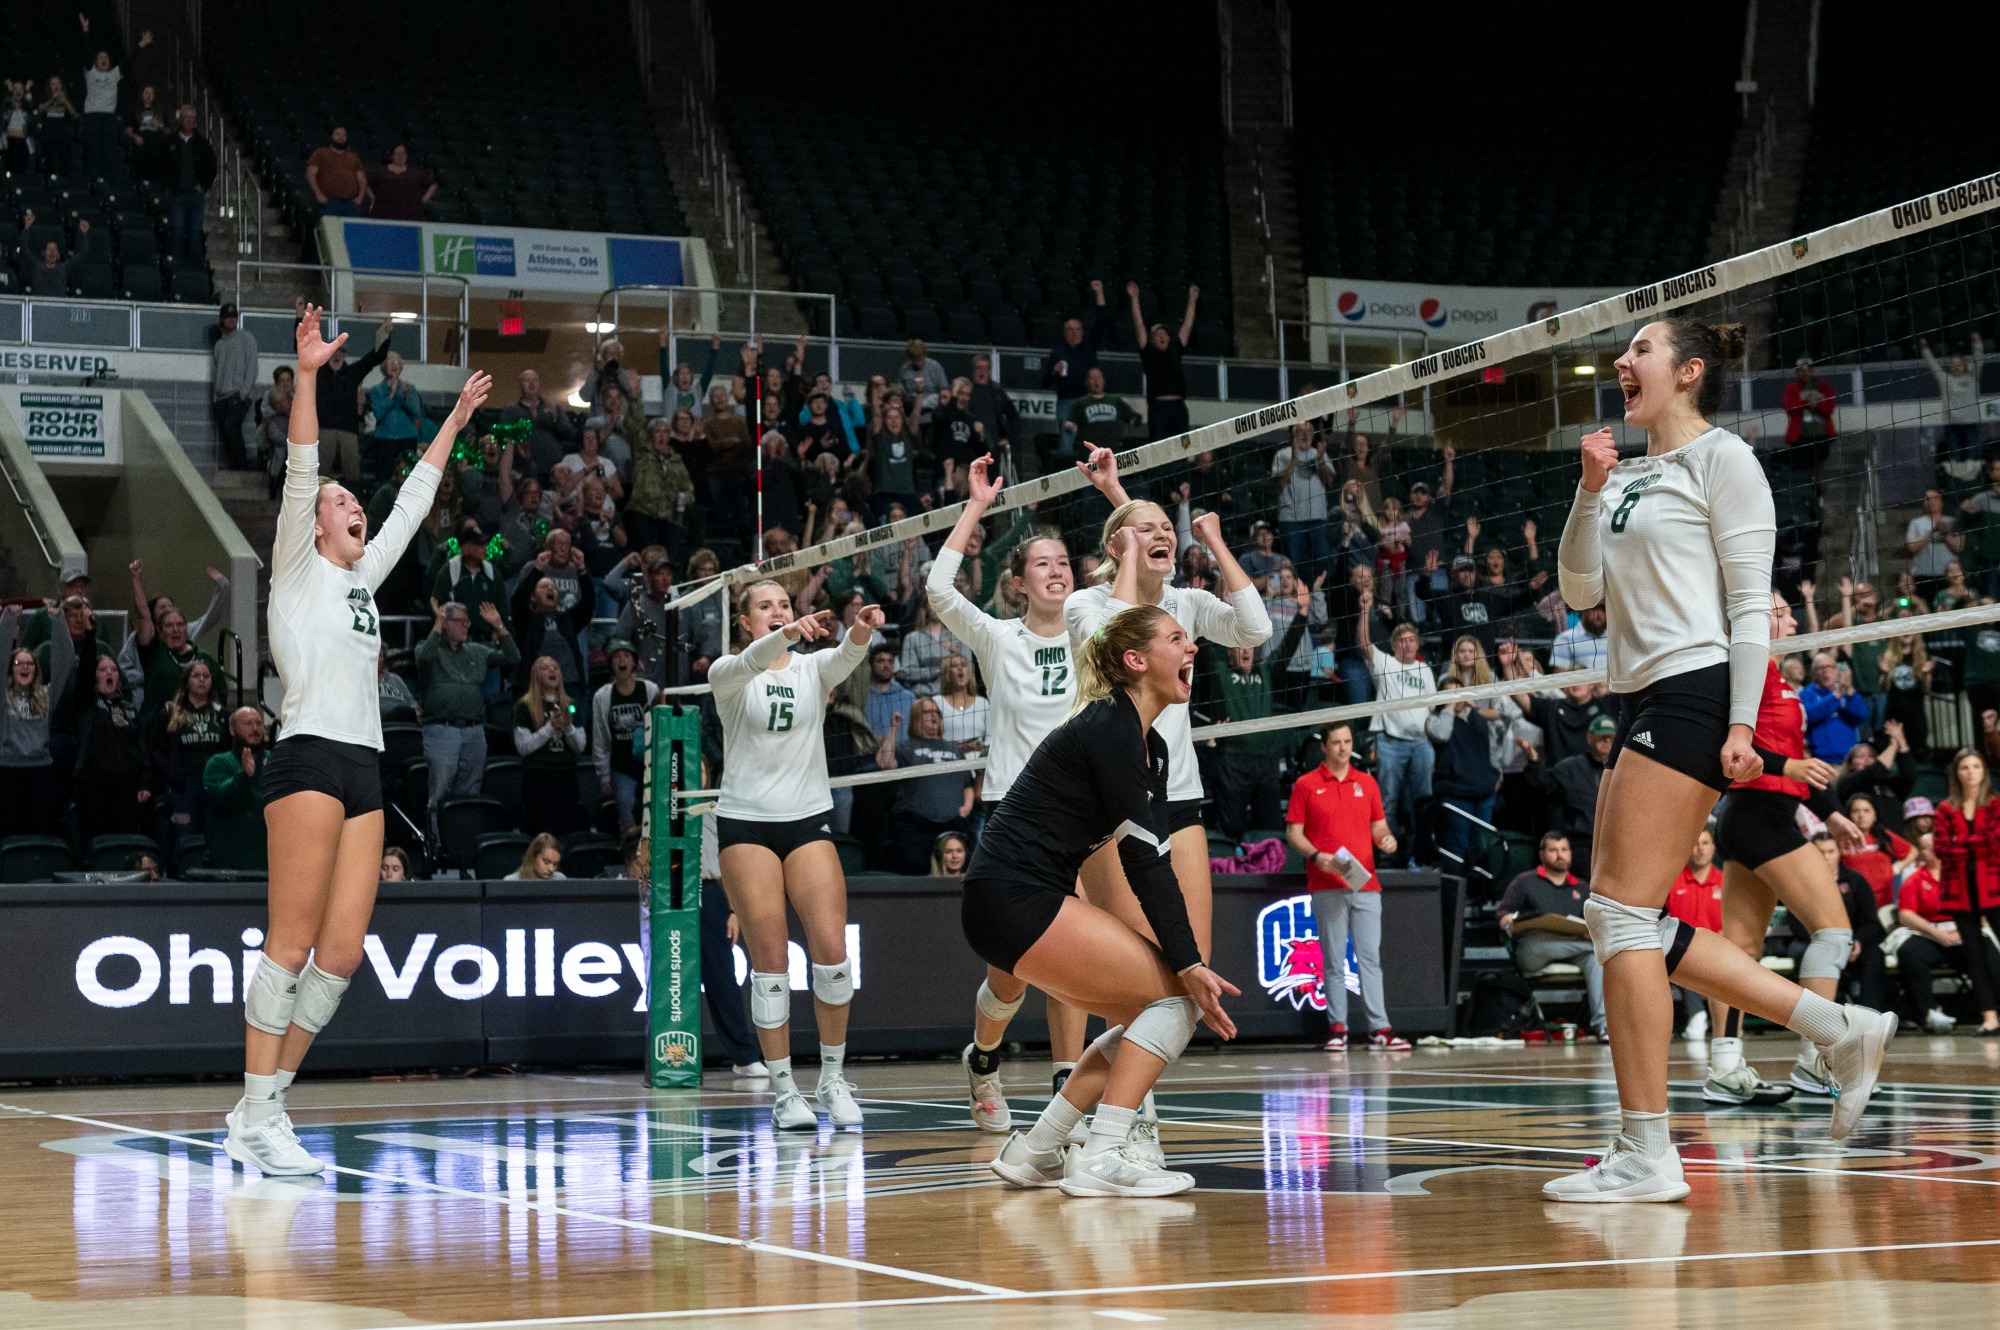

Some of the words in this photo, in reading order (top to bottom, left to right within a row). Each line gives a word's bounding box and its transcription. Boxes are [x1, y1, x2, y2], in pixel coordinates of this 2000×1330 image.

[1892, 197, 1932, 229] OHIO
[528, 254, 576, 268] Athens,
[579, 256, 598, 267] OH
[1625, 285, 1658, 314] OHIO
[1662, 266, 1717, 302] BOBCATS
[1370, 302, 1416, 318] pepsi
[1451, 308, 1498, 324] pepsi
[0, 352, 108, 372] ESERVED
[1411, 355, 1438, 380] OHIO
[1442, 340, 1486, 370] BOBCATS
[29, 411, 97, 424] ROHR
[1235, 413, 1257, 435] OHIO
[1259, 400, 1298, 427] BOBCATS
[29, 425, 98, 438] ROOM
[1611, 492, 1640, 533] 8
[1034, 647, 1066, 667] OHIO
[766, 684, 795, 699] OHIO
[1041, 665, 1068, 696] 12
[767, 702, 793, 732] 15
[1632, 735, 1655, 749] adidas
[668, 929, 681, 971] sports
[668, 972, 681, 1022] imports
